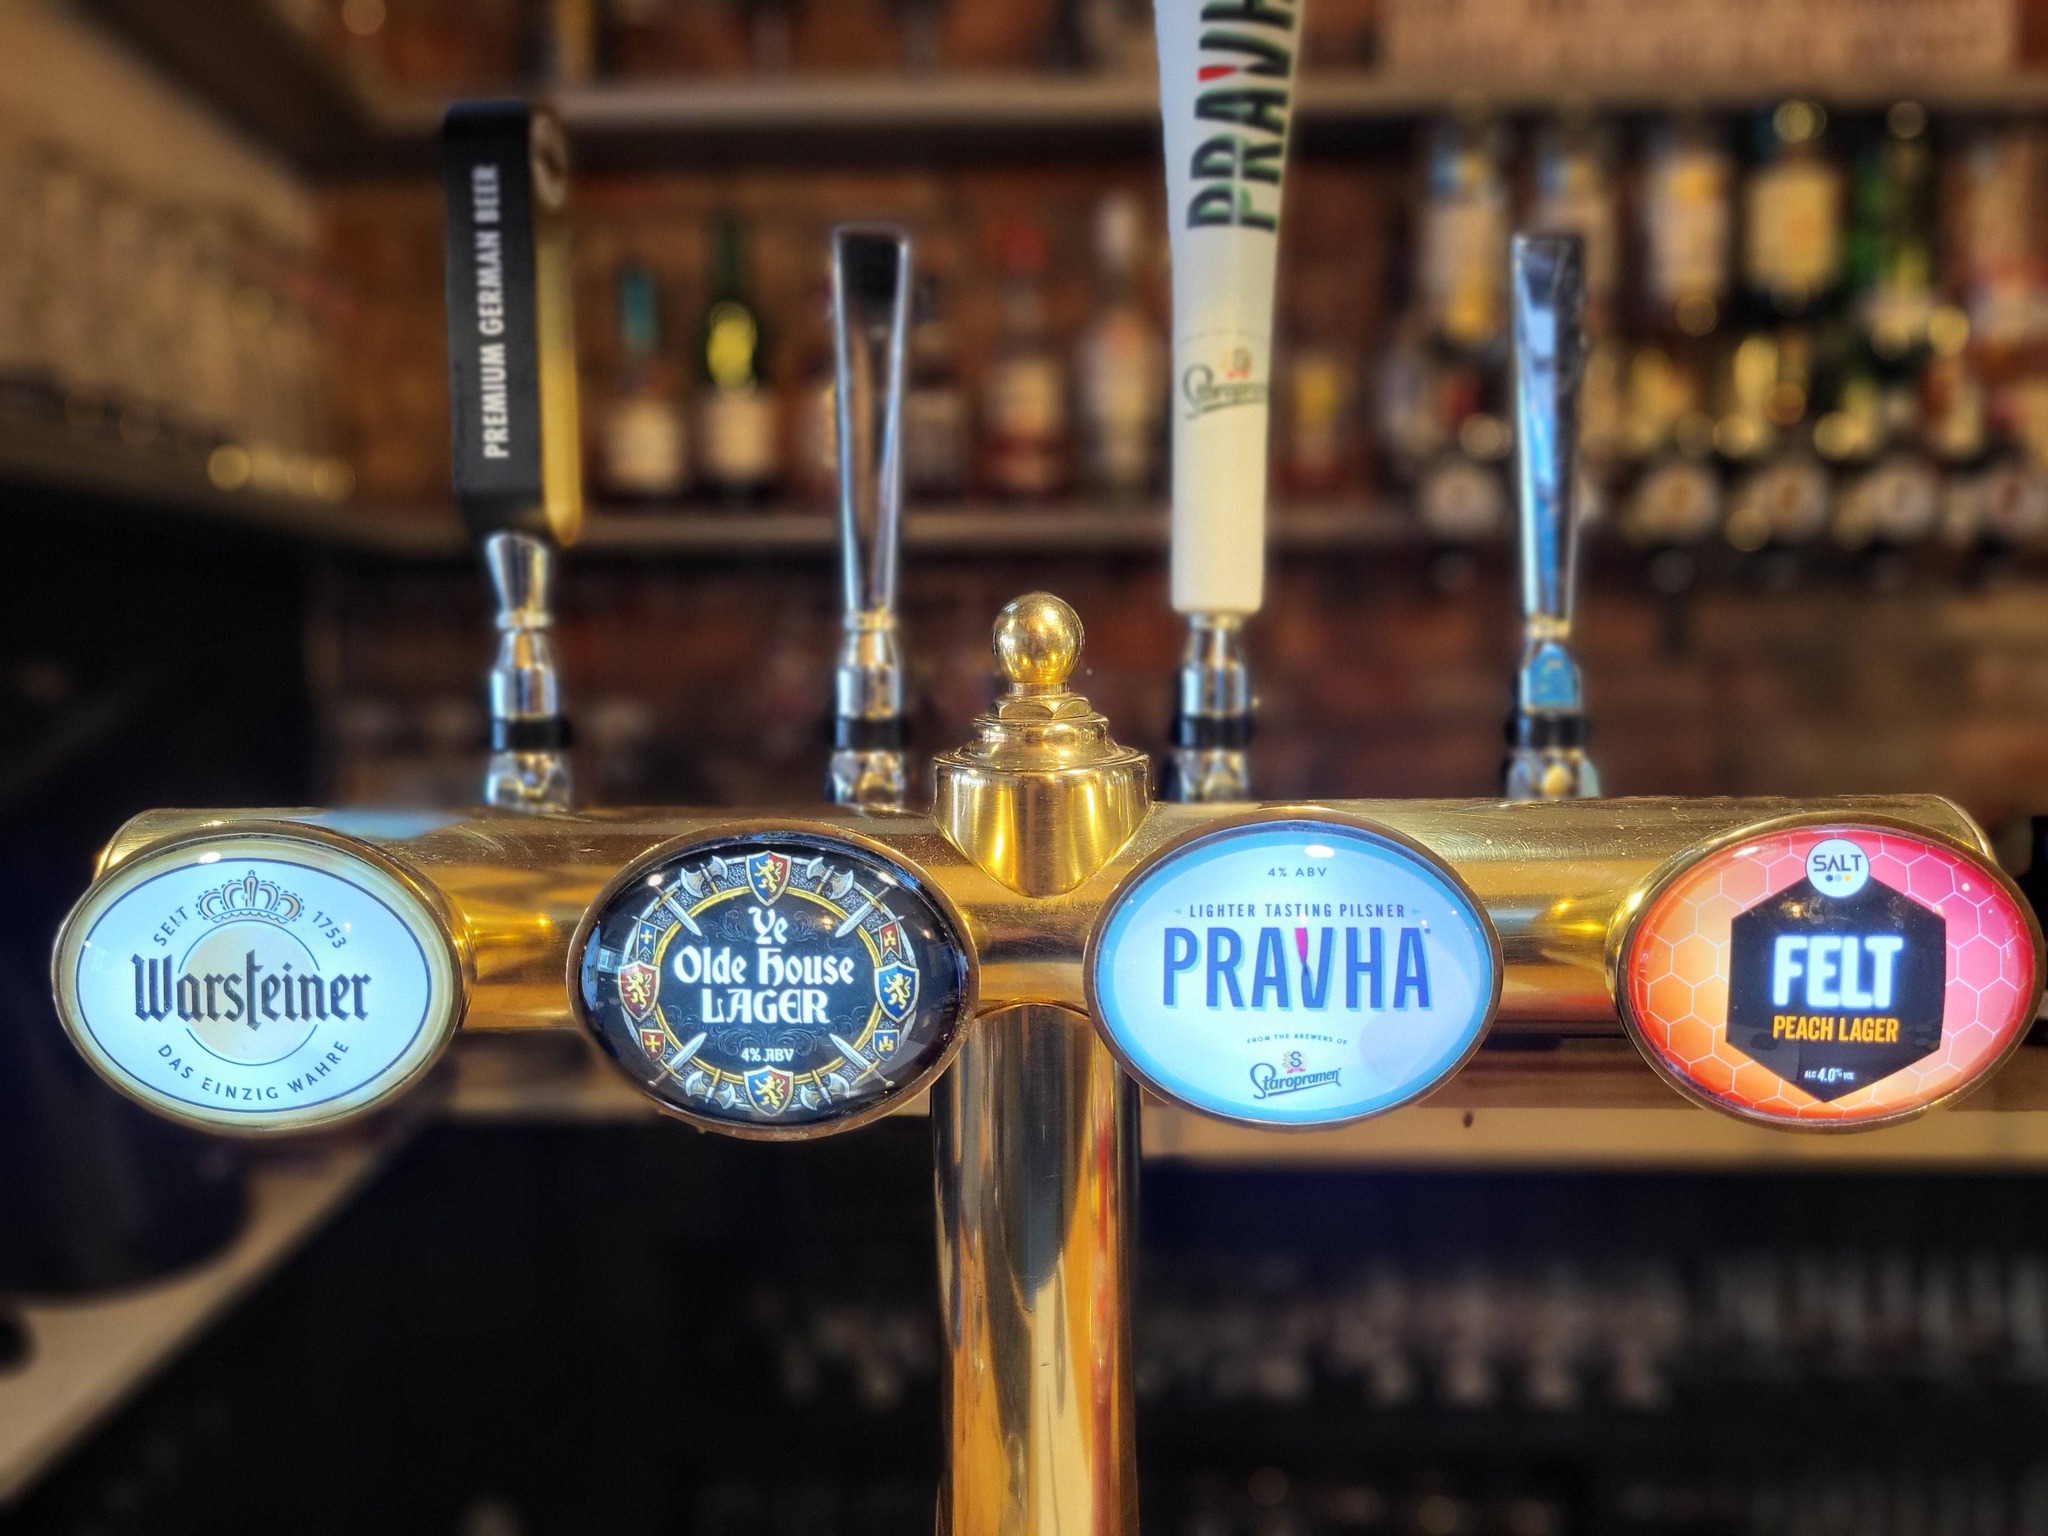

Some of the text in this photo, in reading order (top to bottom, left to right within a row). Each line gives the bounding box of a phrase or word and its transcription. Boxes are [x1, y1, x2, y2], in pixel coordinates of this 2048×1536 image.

[471, 164, 509, 459] PREMIUM GERMAN BEER
[1268, 867, 1327, 877] 4% ABV
[1812, 853, 1862, 873] SALT
[153, 905, 347, 950] SEIT 1753
[748, 906, 789, 945] Ye
[1190, 903, 1405, 918] LIGHTER TASTING PILSNER
[673, 945, 747, 985] Olde
[1163, 926, 1432, 1010] PRAVHA
[1772, 934, 1904, 1009] FELT
[130, 948, 373, 1031] Warsteiner
[701, 988, 831, 1025] LAGER
[1246, 1034, 1271, 1044] FROM
[1294, 1033, 1334, 1043] BREWERS
[1772, 1015, 1900, 1043] PEACH LAGER
[157, 1040, 349, 1101] DAS EINZIG WAHRE
[740, 1047, 795, 1062] 4% ABV
[1249, 1062, 1342, 1100] Staropramen
[1804, 1070, 1817, 1079] ALC
